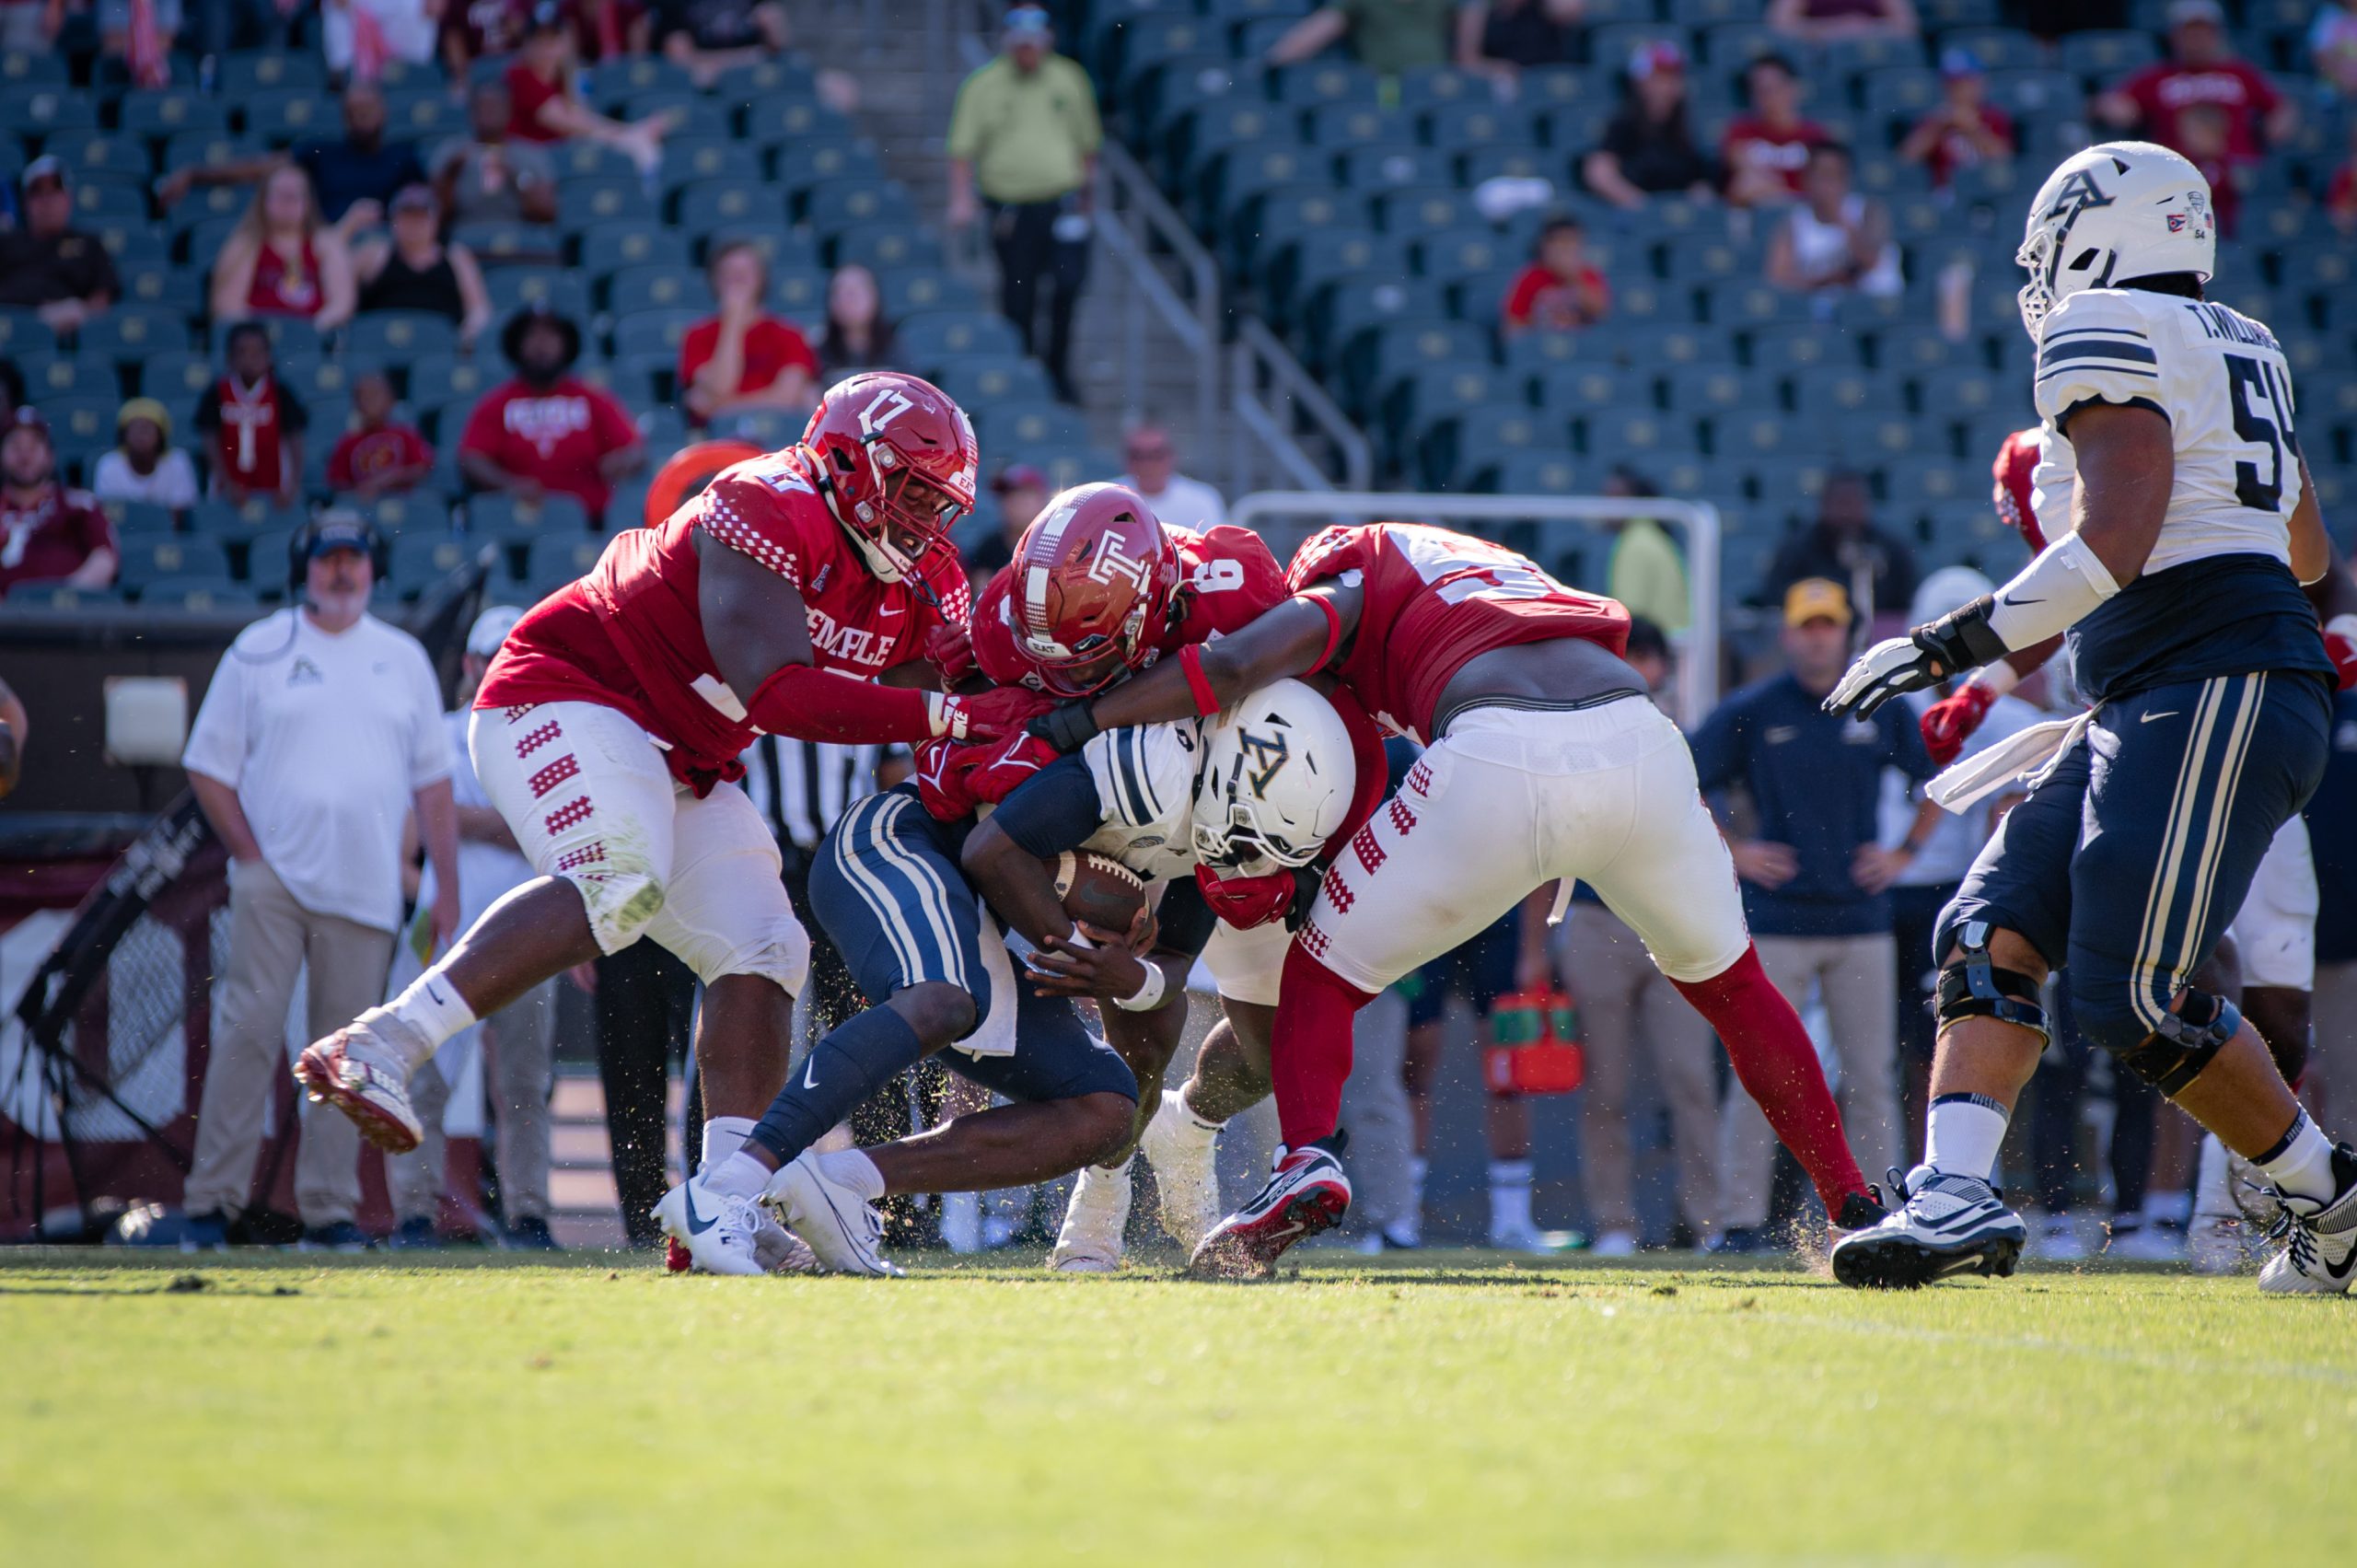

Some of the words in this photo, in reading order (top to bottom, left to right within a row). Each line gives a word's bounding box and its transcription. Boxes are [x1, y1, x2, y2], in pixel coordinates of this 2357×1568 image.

[2195, 229, 2205, 239] 54
[858, 389, 913, 432] 17
[2223, 353, 2299, 513] 54
[959, 477, 974, 494] EAT
[805, 605, 896, 667] EMPLE
[1032, 643, 1056, 654] EAT
